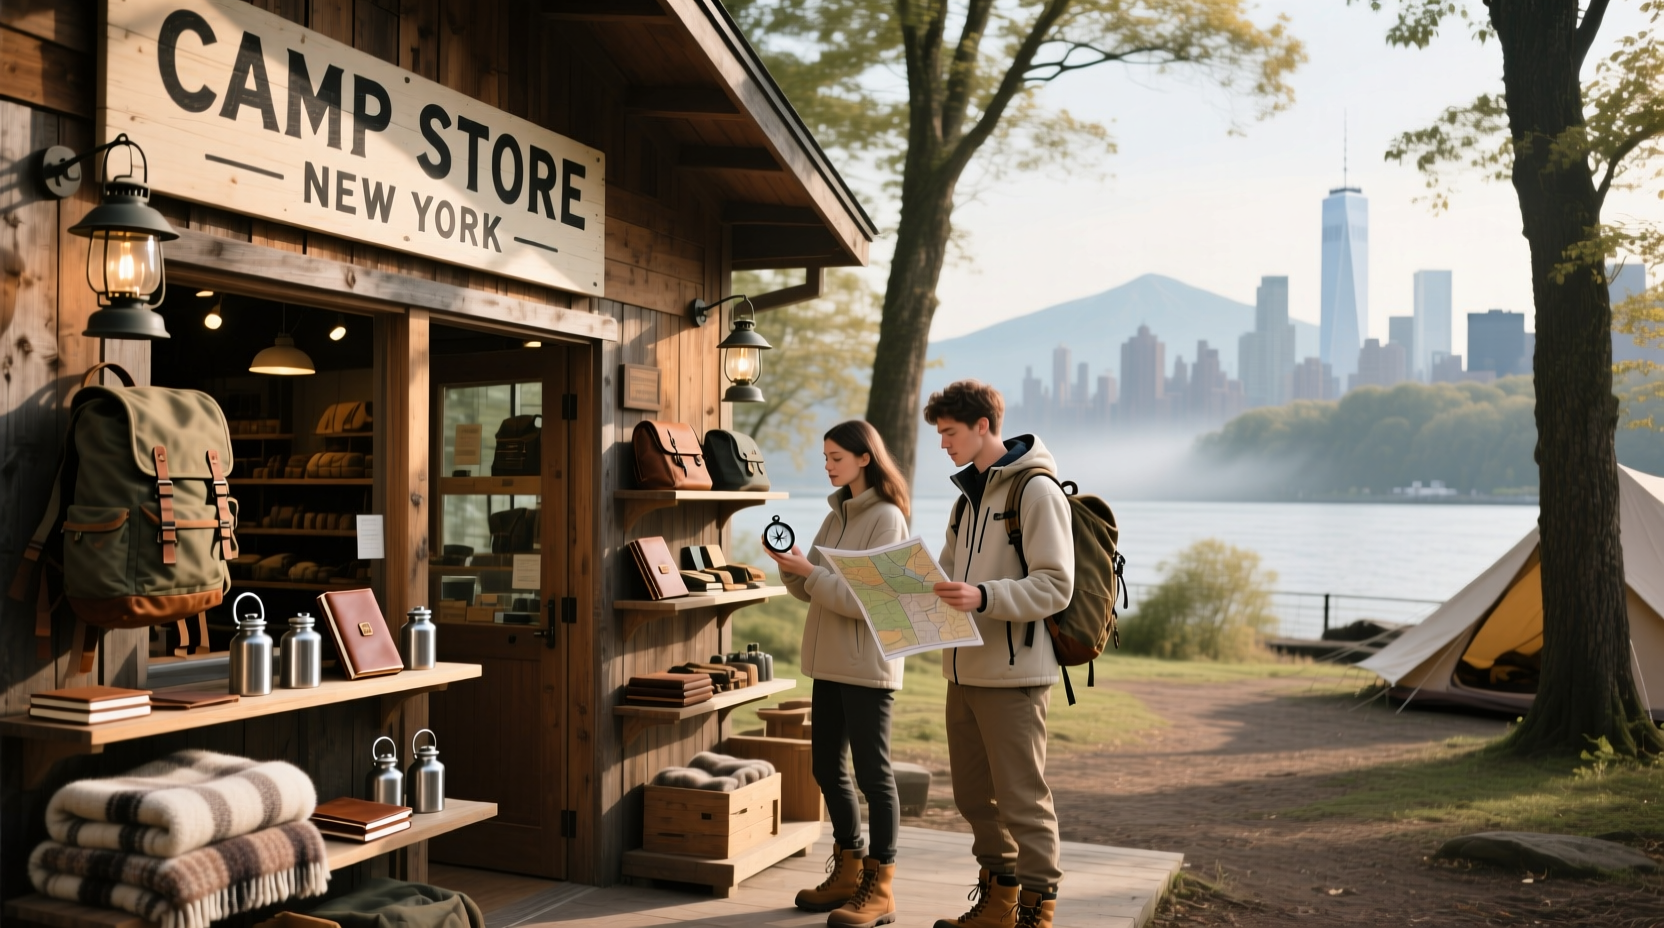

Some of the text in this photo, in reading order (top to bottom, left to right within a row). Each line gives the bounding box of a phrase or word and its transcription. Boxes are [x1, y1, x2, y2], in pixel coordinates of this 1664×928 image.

[158, 10, 586, 230] CAMP STORE
[304, 161, 502, 253] NEW YORK
